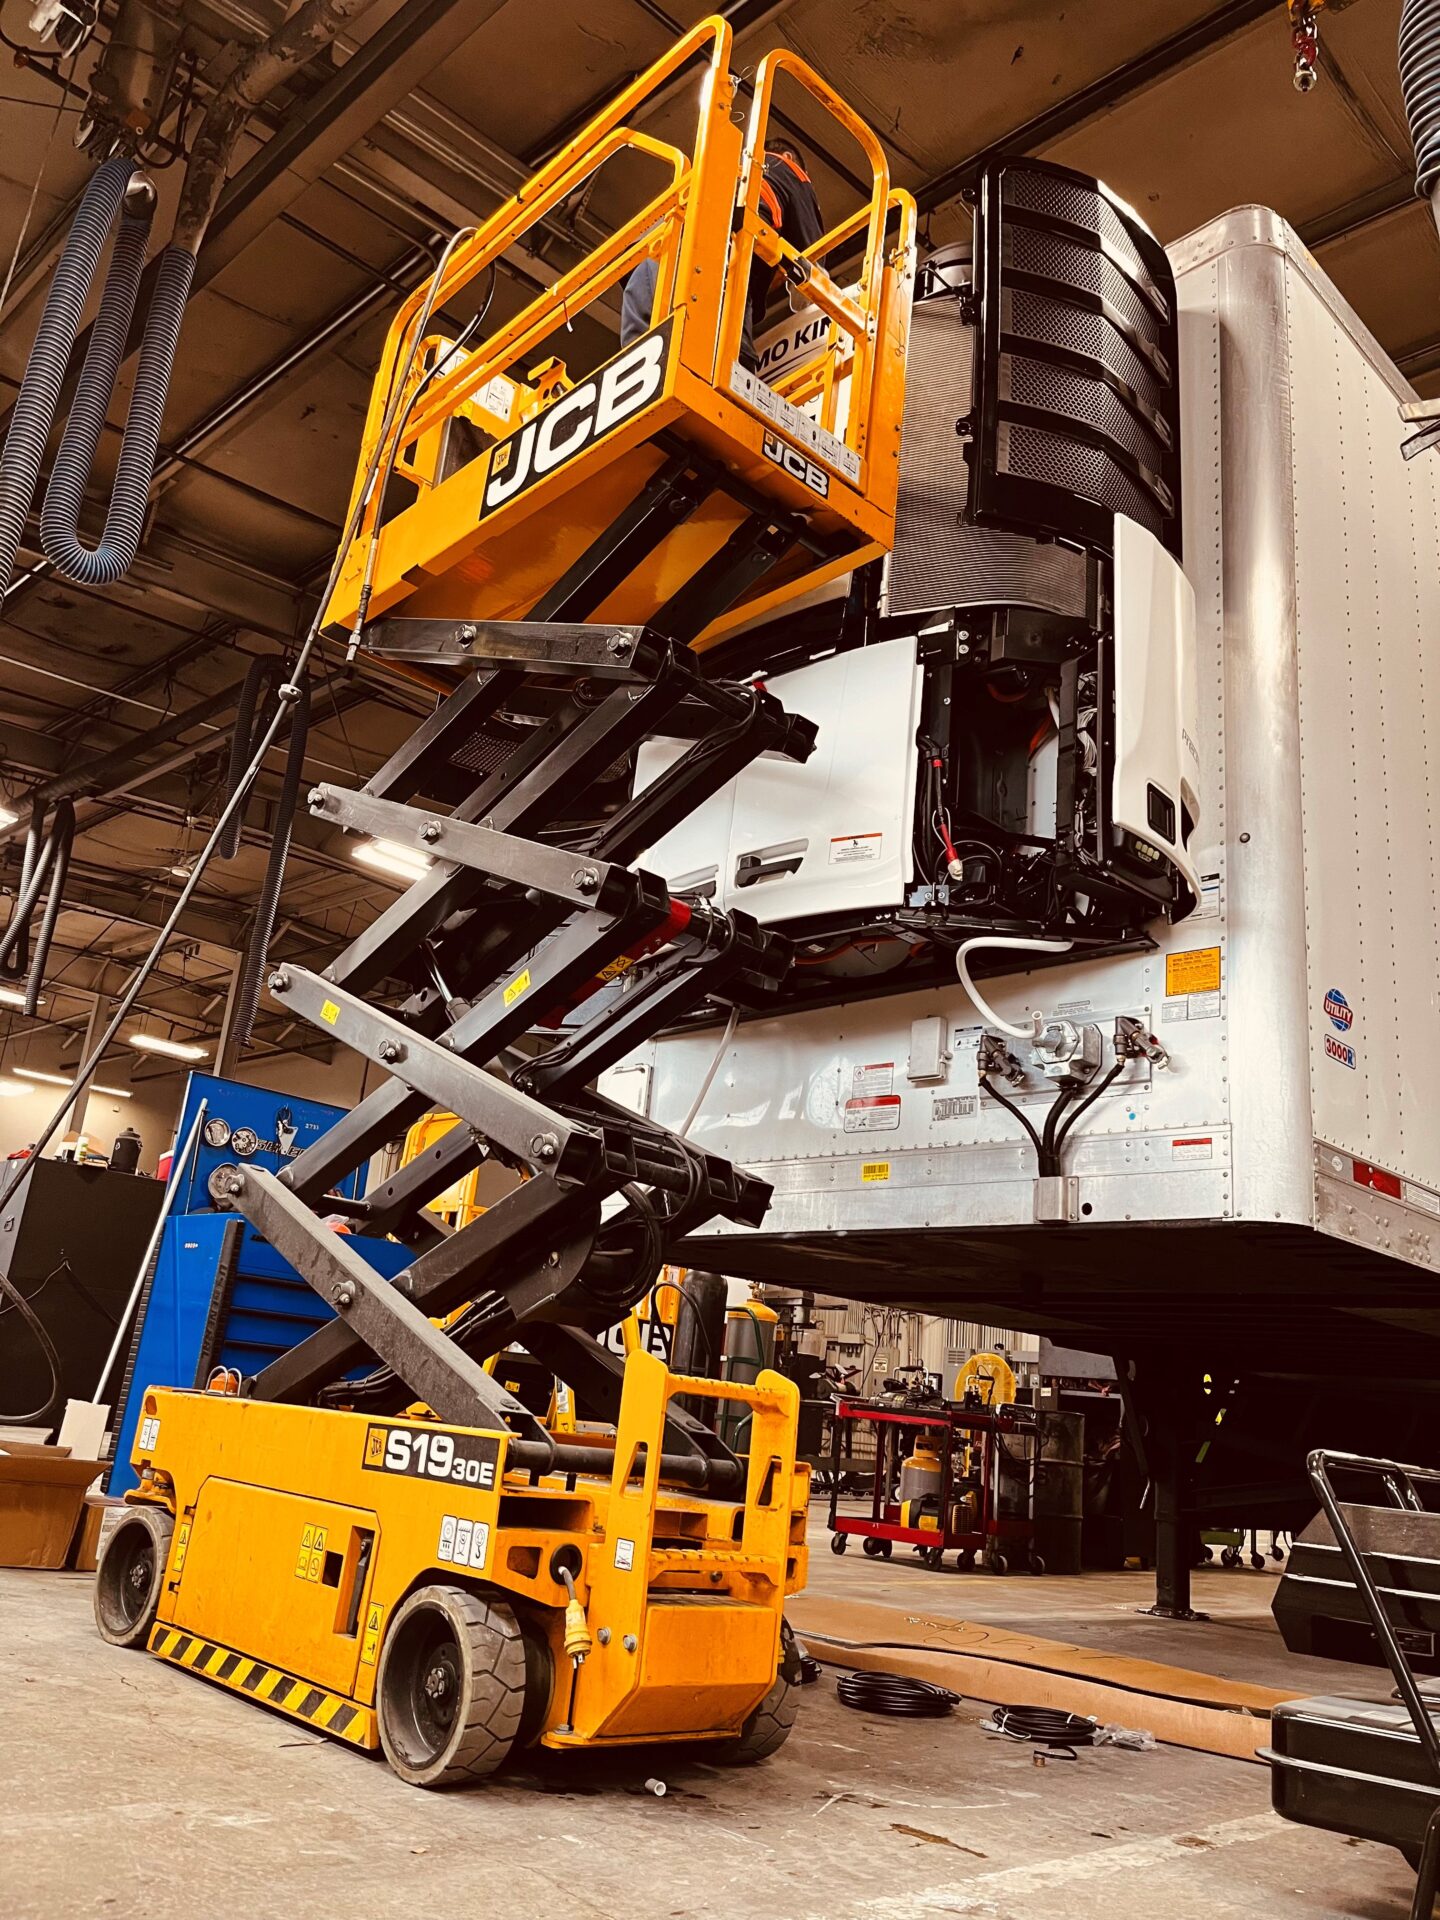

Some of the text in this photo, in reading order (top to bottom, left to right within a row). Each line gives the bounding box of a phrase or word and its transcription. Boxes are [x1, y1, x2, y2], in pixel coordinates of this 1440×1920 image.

[486, 335, 664, 507] JCB
[764, 441, 828, 495] JCB
[1325, 999, 1352, 1022] UTILITY
[1326, 1038, 1353, 1066] 3000R
